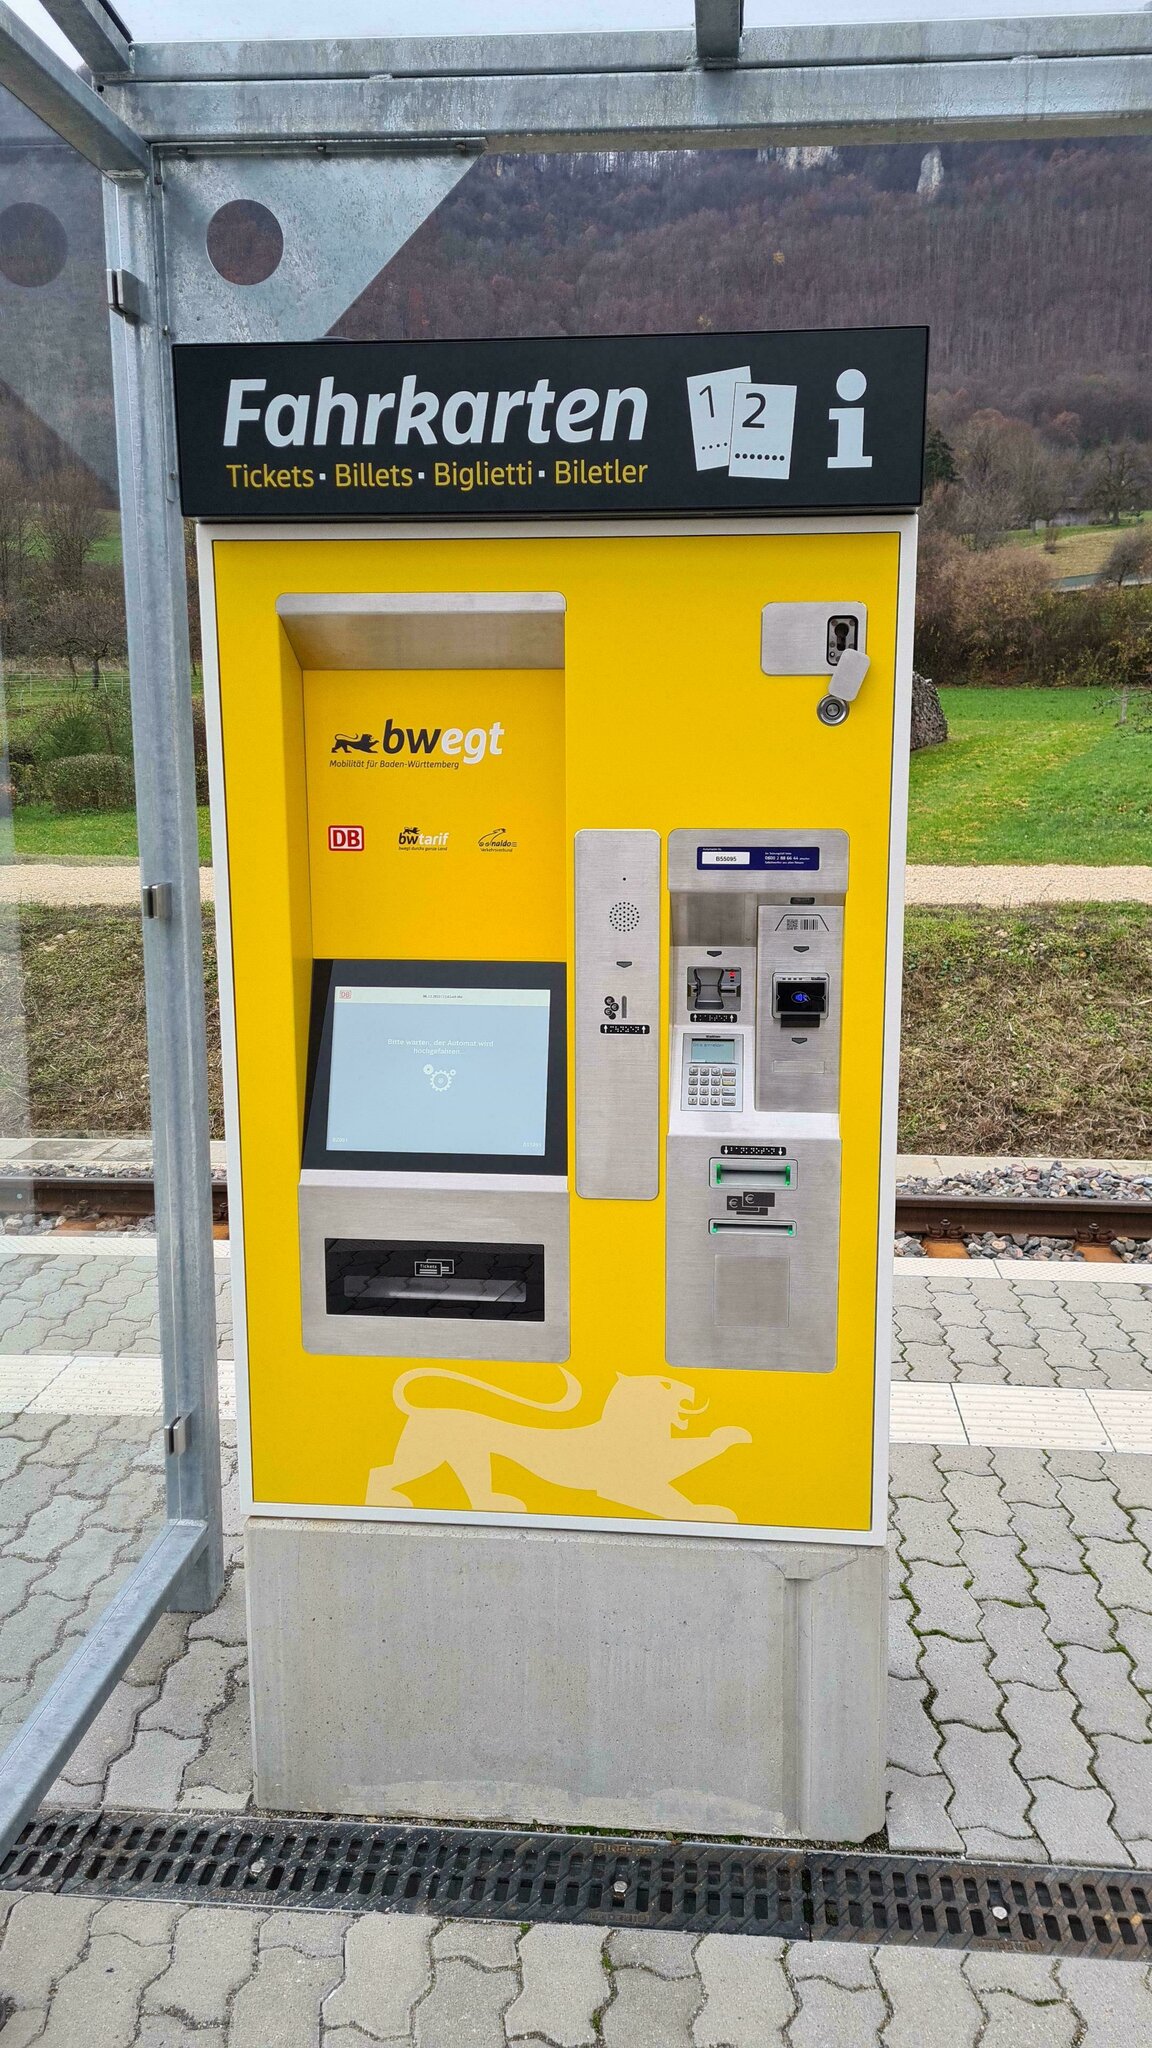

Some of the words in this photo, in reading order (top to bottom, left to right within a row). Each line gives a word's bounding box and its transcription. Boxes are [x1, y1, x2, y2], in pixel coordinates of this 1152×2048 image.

[223, 374, 649, 449] Fahrkarten
[698, 384, 717, 419] 1
[742, 392, 766, 429] 2
[226, 462, 315, 490] Tickets
[335, 461, 413, 489] Billets
[433, 459, 533, 495] Biglietti
[555, 459, 649, 486] Biletler
[382, 718, 505, 765] bwegt
[329, 759, 365, 769] Mobilität
[365, 759, 379, 770] für
[379, 759, 460, 770] Baden-Württemberg
[331, 828, 361, 848] DB
[398, 832, 450, 846] bwtarif
[477, 1040, 494, 1048] wird
